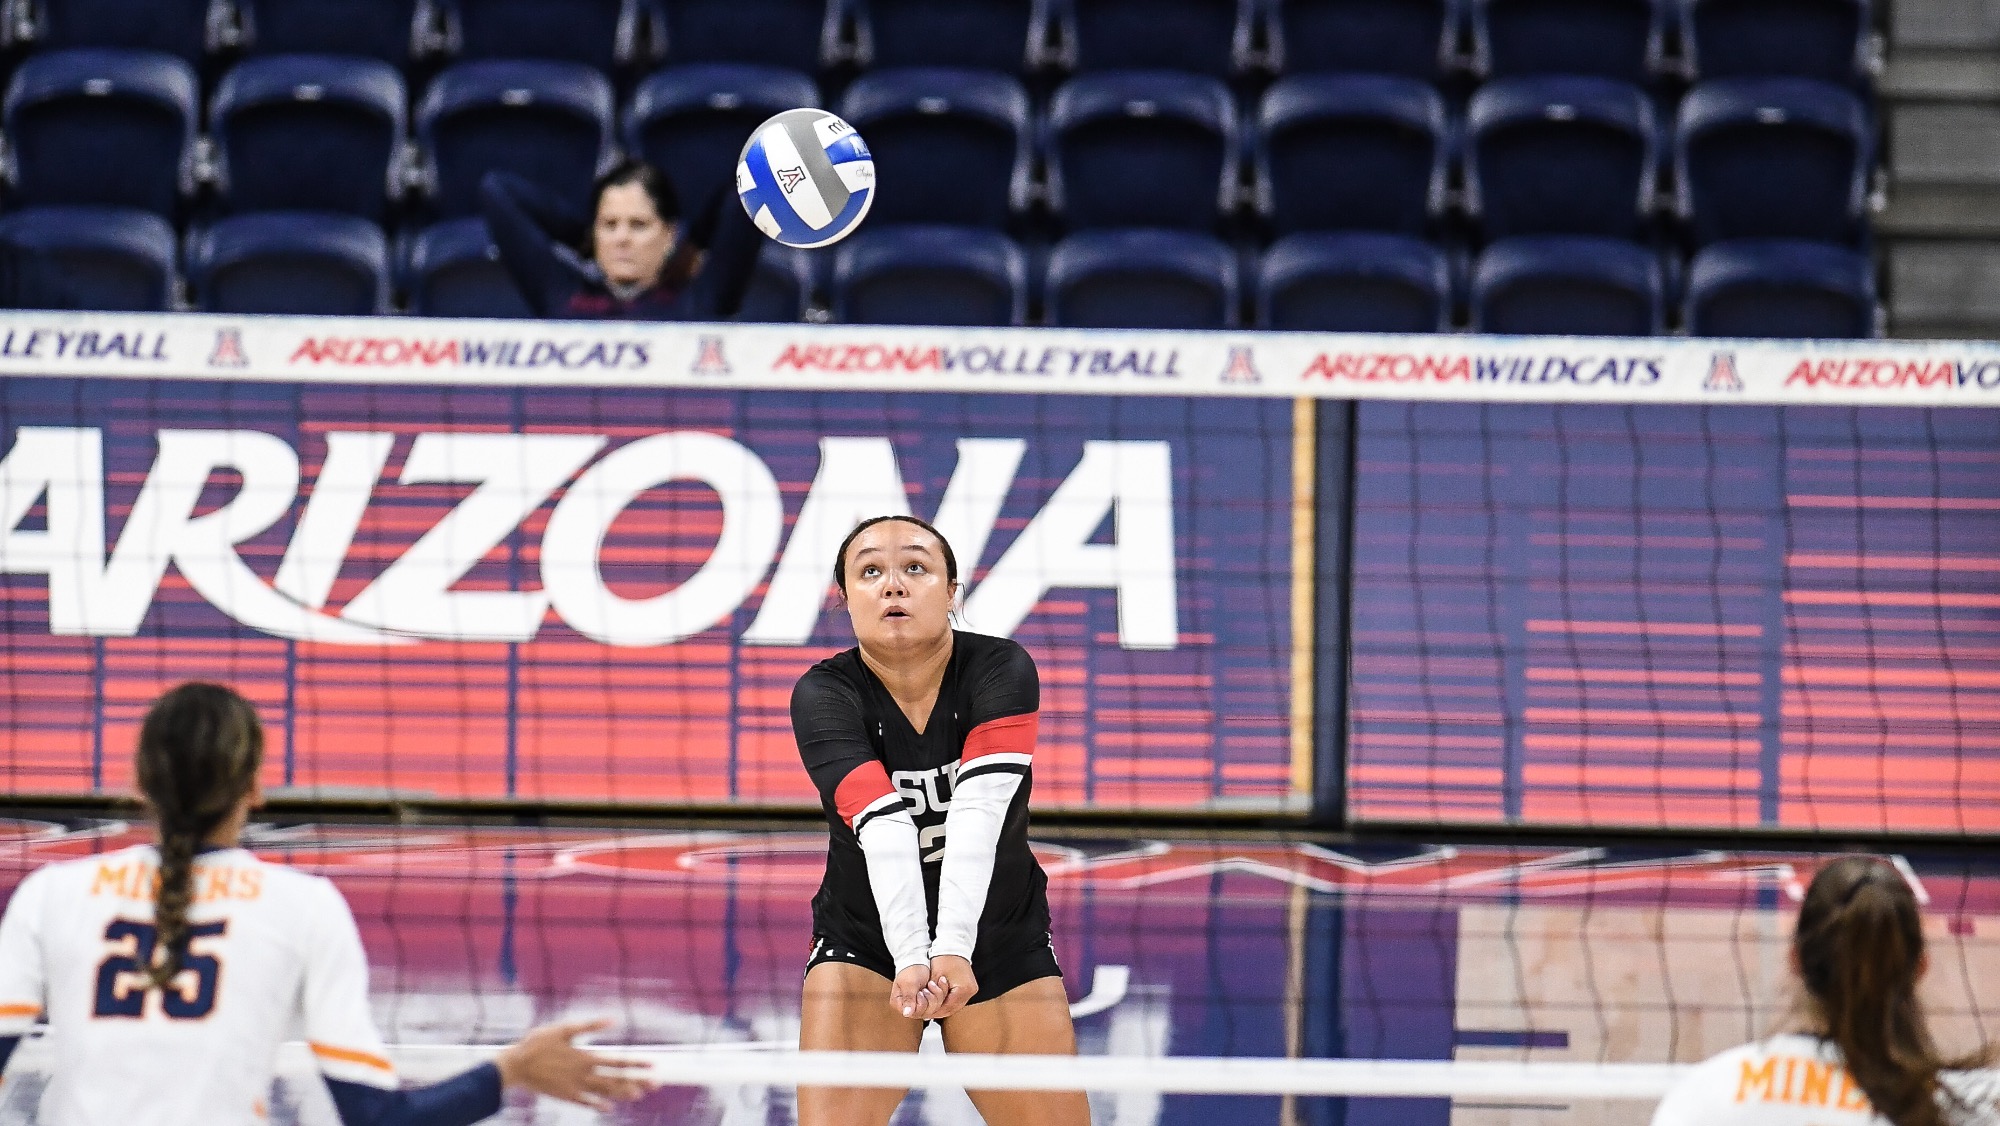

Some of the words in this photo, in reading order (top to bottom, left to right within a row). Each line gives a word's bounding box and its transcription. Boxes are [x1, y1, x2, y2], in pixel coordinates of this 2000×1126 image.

[290, 336, 654, 369] ARIZONAWILDCATS
[773, 343, 1180, 379] ARIZONAVOLLEYBALL
[1302, 352, 1663, 386] ARIZONAWILDCATS
[0, 426, 1179, 650] ARIZONA
[92, 914, 228, 1021] 25
